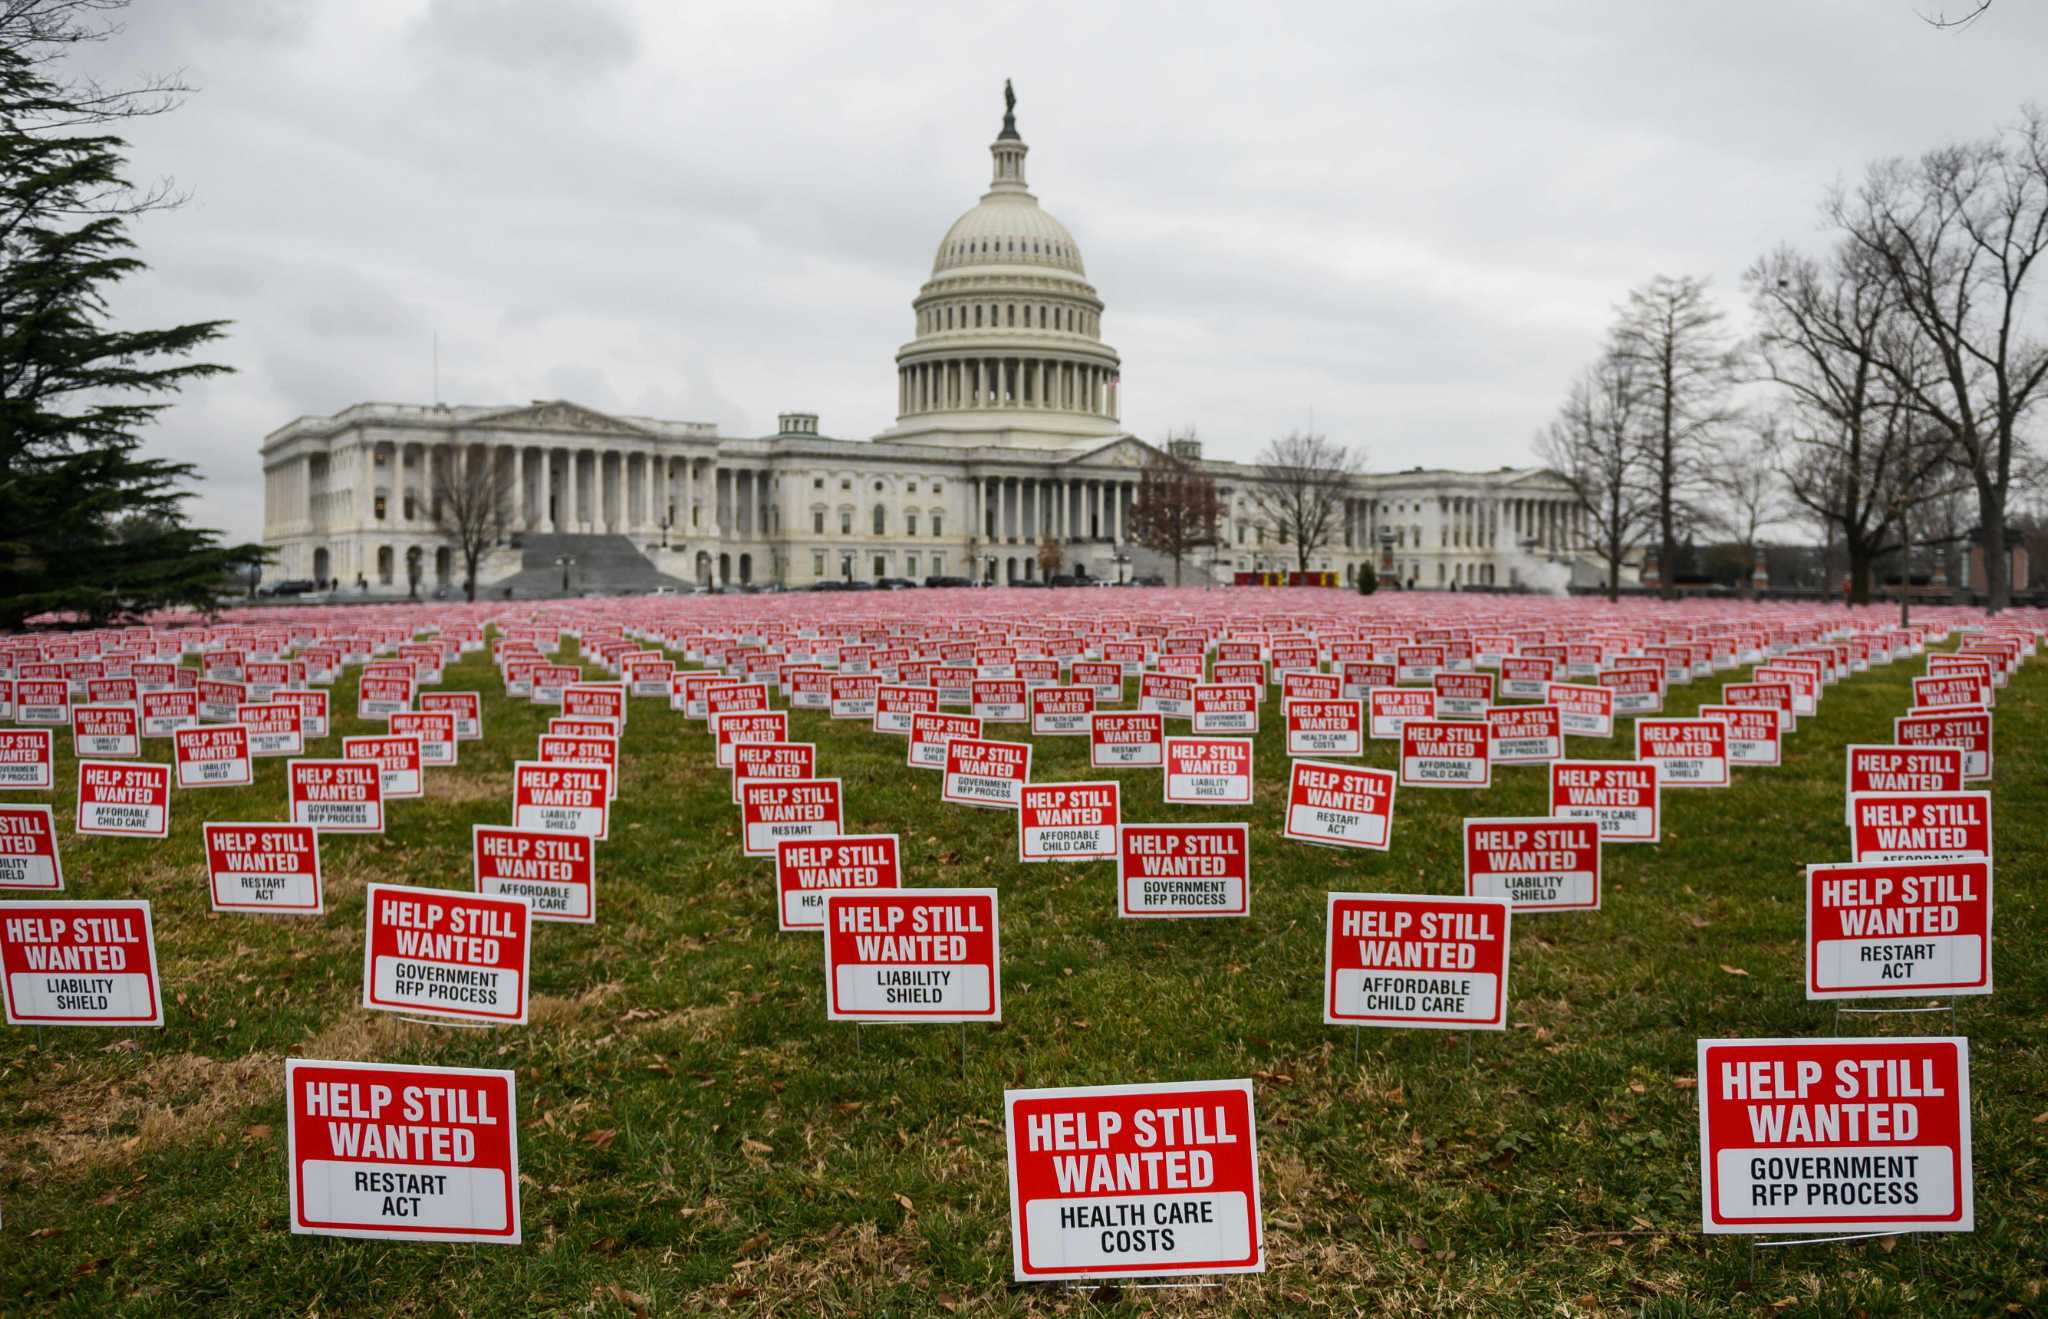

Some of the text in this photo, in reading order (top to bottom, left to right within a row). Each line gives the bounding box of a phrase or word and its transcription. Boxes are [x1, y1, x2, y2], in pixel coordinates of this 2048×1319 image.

[78, 712, 134, 724] HELP STILL
[1292, 705, 1355, 717] HELP STILL
[85, 723, 126, 735] WANTED
[1299, 718, 1348, 730] WANTED
[180, 731, 243, 749] HELP STILL
[1408, 728, 1484, 742] HELP STILL
[1644, 727, 1721, 741] HELP STILL
[189, 747, 237, 760] WANTED
[952, 744, 1023, 763] HELP STILL
[1172, 746, 1245, 760] HELP STILL
[1416, 742, 1474, 756] WANTED
[1652, 742, 1712, 756] WANTED
[199, 763, 231, 772] LIABILITY
[959, 759, 1014, 777] WANTED
[1180, 760, 1237, 774] WANTED
[1418, 761, 1472, 770] AFFORDABLE
[1664, 761, 1703, 769] LIABILITY
[1858, 756, 1899, 771] HELP
[1906, 756, 1954, 773] STILL
[86, 769, 162, 789] HELP STILL
[204, 770, 228, 779] SHIELD
[297, 768, 374, 784] HELP STILL
[522, 771, 602, 789] HELP STILL
[1421, 769, 1469, 779] CHILD CARE
[1558, 771, 1650, 788] HELP STILL
[1670, 769, 1699, 778] SHIELD
[1868, 773, 1943, 790] WANTED
[958, 777, 1012, 789] GOVERNMENT
[1191, 778, 1229, 787] LIABILITY
[1299, 770, 1386, 797] HELP STILL
[95, 786, 152, 804] WANTED
[307, 784, 365, 800] WANTED
[531, 789, 592, 806] WANTED
[749, 786, 833, 804] HELP STILL
[957, 786, 1011, 798] RFP PROCESS
[1027, 791, 1111, 808] HELP STILL
[1195, 788, 1225, 796] SHIELD
[1308, 788, 1375, 812] WANTED
[1568, 788, 1639, 805] WANTED
[96, 807, 149, 819] AFFORDABLE
[308, 804, 366, 813] GOVERNMENT
[540, 810, 581, 820] LIABILITY
[759, 805, 824, 821] WANTED
[1613, 809, 1637, 820] CARE
[1862, 804, 1980, 827] HELP STILL
[0, 816, 45, 834] STILL
[98, 817, 147, 828] CHILD CARE
[308, 813, 366, 824] RFP PROCESS
[545, 820, 576, 830] SHIELD
[1036, 809, 1102, 826] WANTED
[1316, 812, 1359, 825] RESTART
[772, 826, 812, 835] RESTART
[1040, 830, 1100, 841] AFFORDABLE
[1327, 824, 1346, 834] ACT
[213, 833, 308, 852] HELP STILL
[1042, 840, 1098, 851] CHILD CARE
[1129, 836, 1238, 854] HELP STILL
[1475, 830, 1590, 850] HELP STILL
[1876, 828, 1967, 849] WANTED
[484, 837, 584, 862] HELP STILL
[786, 846, 889, 868] HELP STILL
[226, 854, 299, 872] WANTED
[496, 859, 572, 881] WANTED
[1142, 857, 1226, 876] WANTED
[1488, 852, 1576, 871] WANTED
[242, 878, 286, 889] RESTART
[798, 868, 878, 888] WANTED
[1144, 881, 1226, 892] GOVERNMENT
[1505, 877, 1562, 889] LIABILITY
[256, 889, 274, 900] ACT
[500, 884, 570, 898] AFFORDABLE
[1144, 894, 1226, 905] RFP PROCESS
[1512, 888, 1556, 900] SHIELD
[1822, 875, 1977, 908] HELP STILL
[539, 899, 567, 910] CARE
[382, 899, 517, 938] HELP STILL
[839, 906, 983, 933] HELP STILL
[1343, 911, 1494, 940] HELP STILL
[1839, 906, 1959, 936] WANTED
[6, 918, 139, 943] HELP STILL
[396, 929, 499, 965] WANTED
[855, 935, 967, 962] WANTED
[1359, 940, 1476, 969] WANTED
[1861, 944, 1935, 961] RESTART
[24, 946, 125, 970] WANTED
[396, 963, 498, 988] GOVERNMENT
[877, 971, 950, 986] LIABILITY
[1881, 963, 1914, 979] ACT
[47, 979, 113, 993] LIABILITY
[396, 980, 497, 1005] RFP PROCESS
[1363, 977, 1470, 995] AFFORDABLE
[57, 996, 108, 1010] SHIELD
[887, 989, 942, 1003] SHIELD
[1367, 995, 1464, 1012] CHILD CARE
[1721, 1058, 1944, 1100] HELP STILL
[305, 1081, 497, 1126] HELP STILL
[1028, 1106, 1237, 1152] HELP STILL
[1748, 1103, 1918, 1143] WANTED
[328, 1122, 475, 1162] WANTED
[1052, 1150, 1214, 1194] WANTED
[1750, 1156, 1918, 1180] GOVERNMENT
[355, 1171, 447, 1196] RESTART
[1752, 1182, 1918, 1206] RFP PROCESS
[381, 1196, 420, 1217] ACT
[1060, 1201, 1213, 1229] HEALTH CARE
[1101, 1228, 1175, 1253] COSTS
